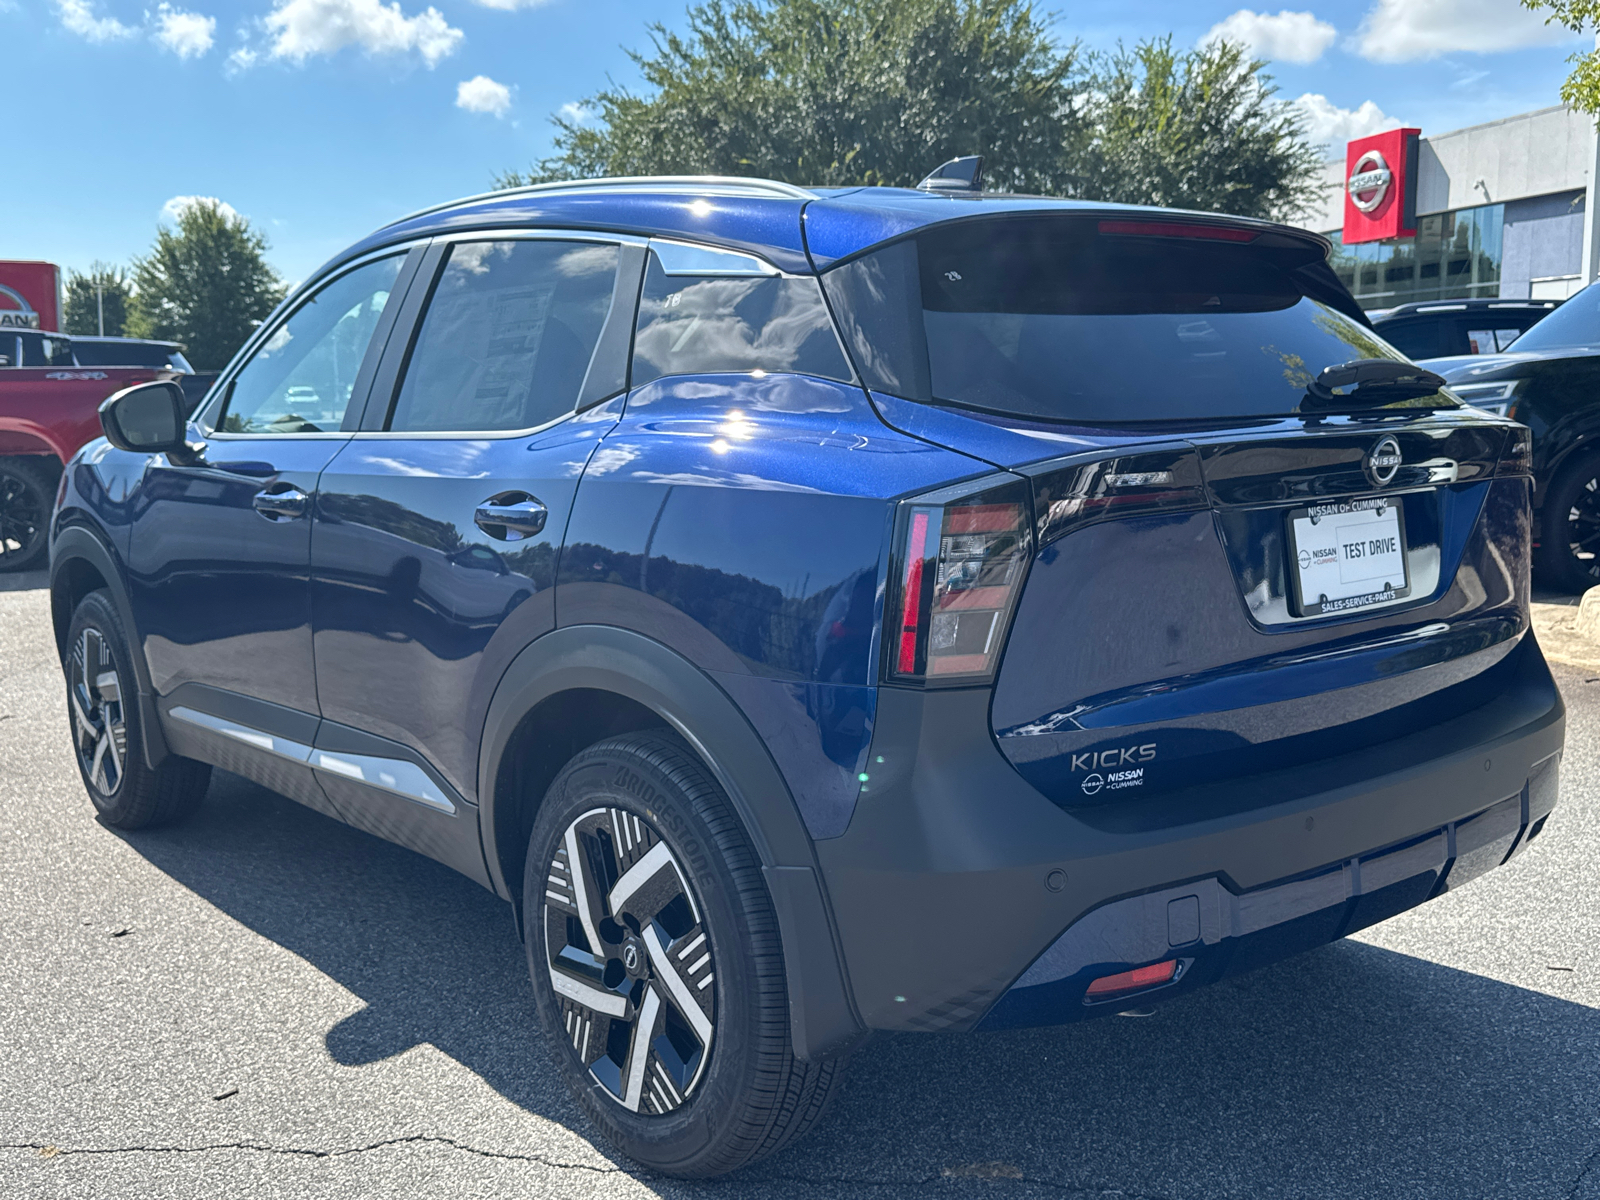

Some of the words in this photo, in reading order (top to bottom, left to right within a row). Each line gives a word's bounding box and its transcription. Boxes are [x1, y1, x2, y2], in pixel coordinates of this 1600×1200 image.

[1308, 503, 1338, 517] NISSAN
[1339, 503, 1351, 513] OF
[1351, 498, 1388, 512] CUMMING
[1312, 547, 1337, 559] NISSAN
[1343, 541, 1367, 560] TEST
[1369, 537, 1396, 556] DRIVE
[1070, 743, 1157, 772] KICKS
[1108, 768, 1143, 782] NISSAN
[1111, 779, 1143, 789] CUMMING
[613, 765, 717, 888] BRIDGESTONE
